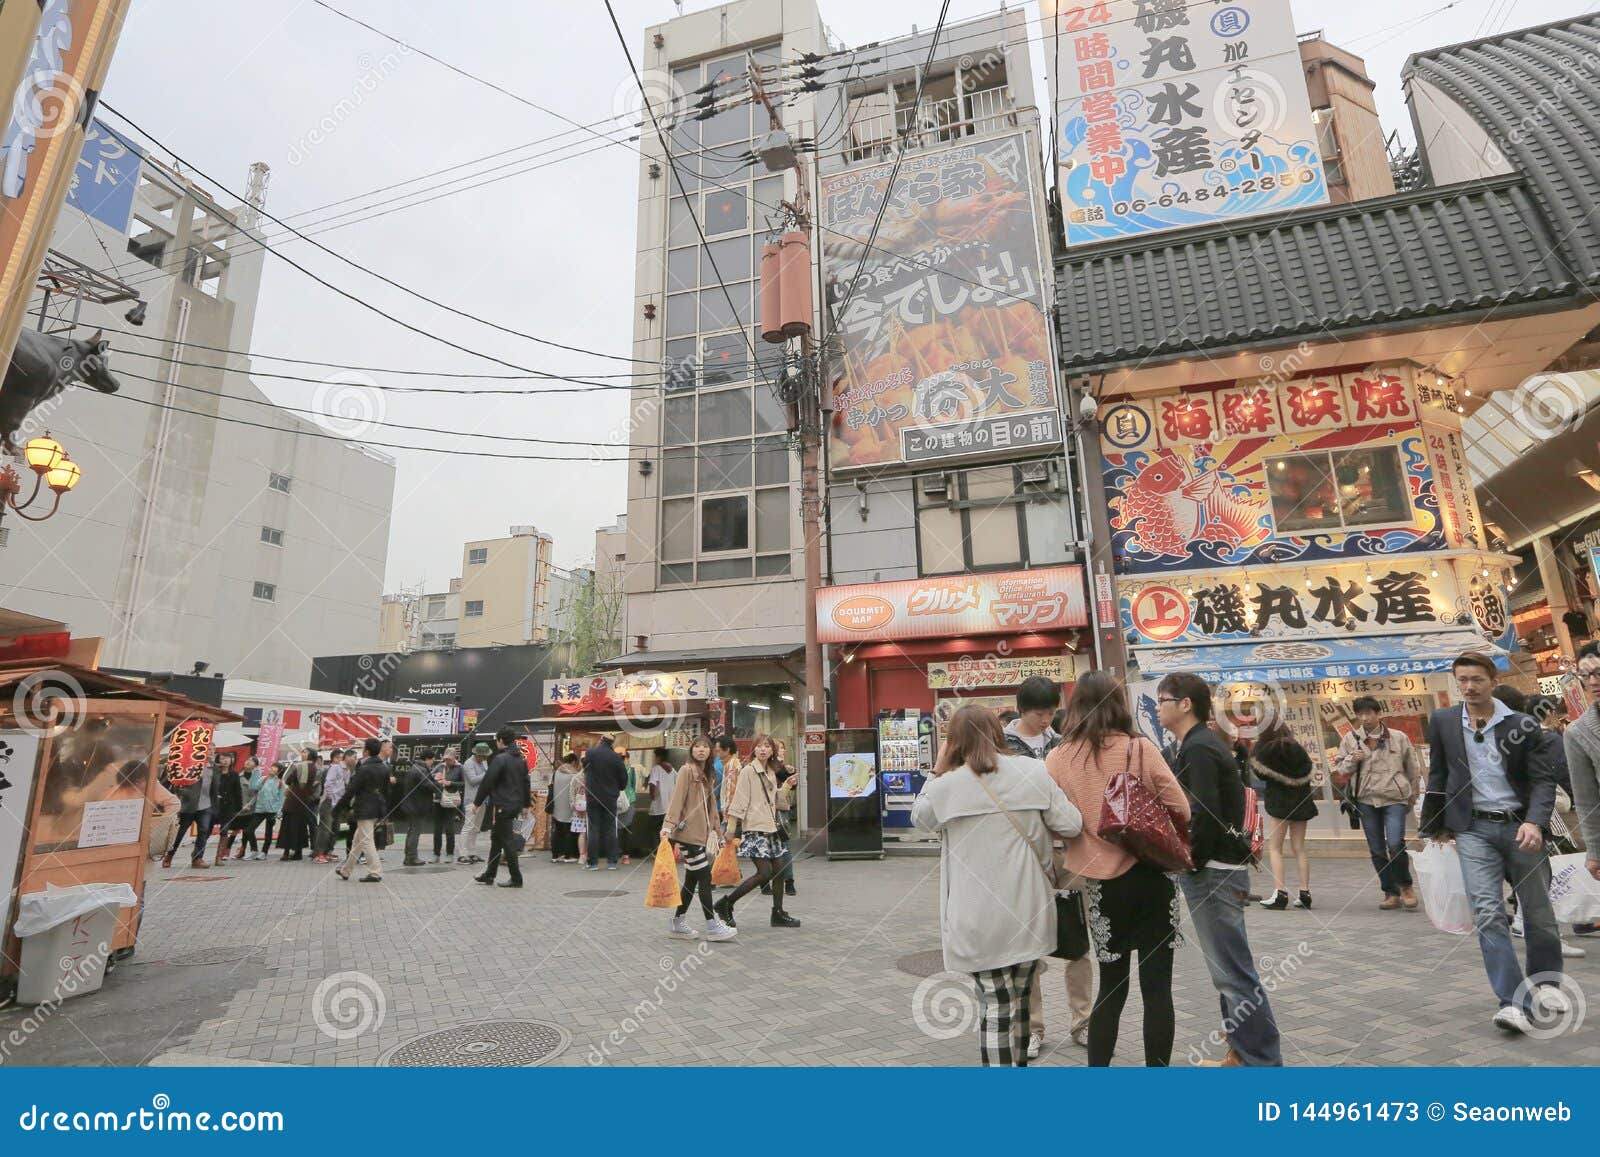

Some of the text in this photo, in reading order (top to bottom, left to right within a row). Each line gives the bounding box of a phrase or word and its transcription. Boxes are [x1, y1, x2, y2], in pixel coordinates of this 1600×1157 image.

[1133, 0, 1214, 177] 磯丸水産
[1114, 169, 1315, 216] 06-6484-2850
[1160, 375, 1411, 441] 海鮮浜焼
[910, 416, 1054, 452] この建物の目の前
[839, 605, 885, 617] GOURMET
[911, 585, 979, 611] グルメ
[993, 597, 1064, 626] マップ
[1192, 571, 1437, 634] 磯丸水産
[851, 616, 873, 625] MAP
[420, 687, 457, 695] KOKUYO
